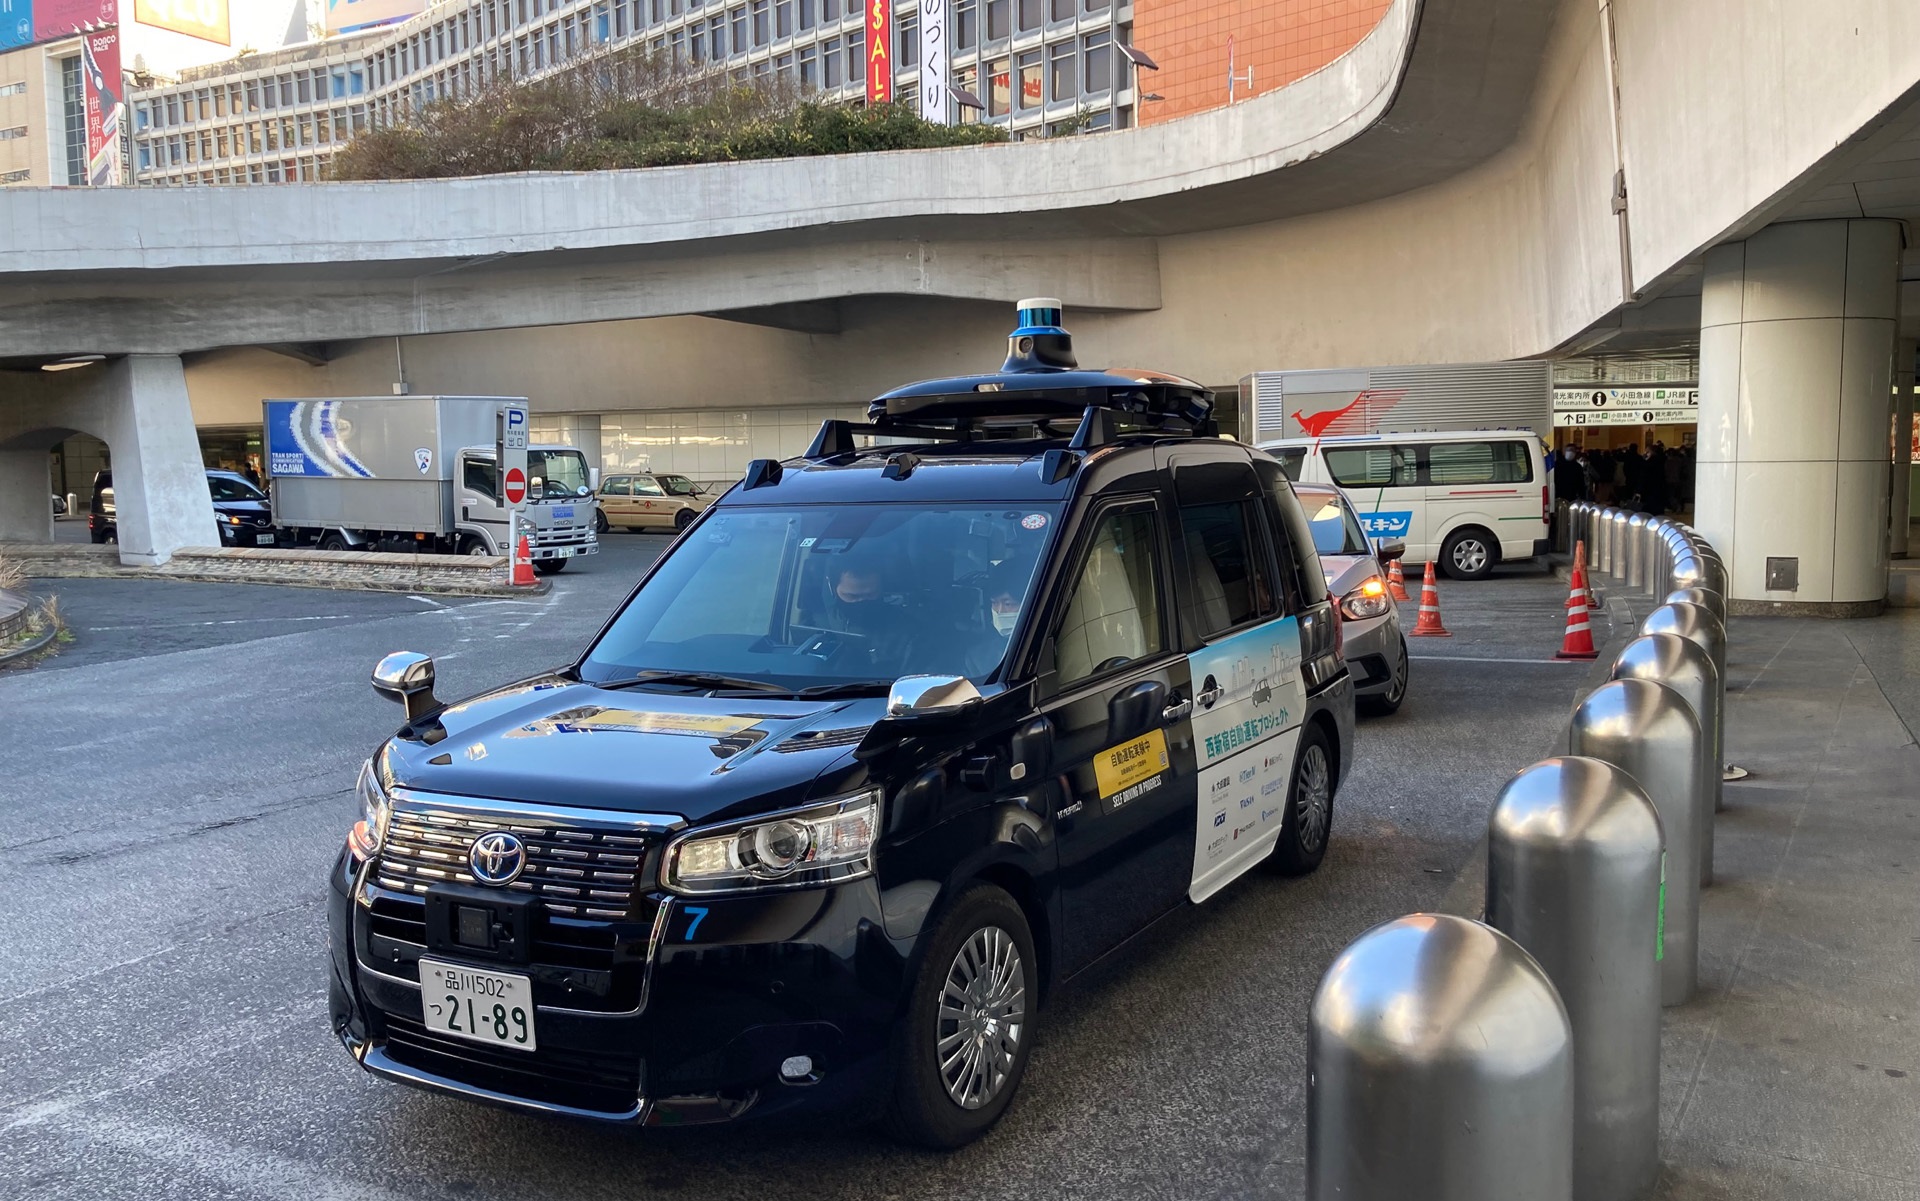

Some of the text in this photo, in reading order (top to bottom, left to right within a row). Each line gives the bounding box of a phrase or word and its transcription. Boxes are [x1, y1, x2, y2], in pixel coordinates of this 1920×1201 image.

[925, 0, 942, 121] のづくり
[89, 96, 102, 154] 世界初
[1616, 399, 1638, 407] Odakyu
[1620, 391, 1652, 399] 小田急線
[1666, 391, 1687, 399] JR線
[509, 410, 524, 430] P
[272, 463, 305, 474] SAGAWA
[1205, 706, 1289, 760] 西新宿自動運転プロジェクト
[1112, 792, 1123, 808] SELF
[683, 906, 709, 941] 7
[445, 994, 528, 1044] 21-89
